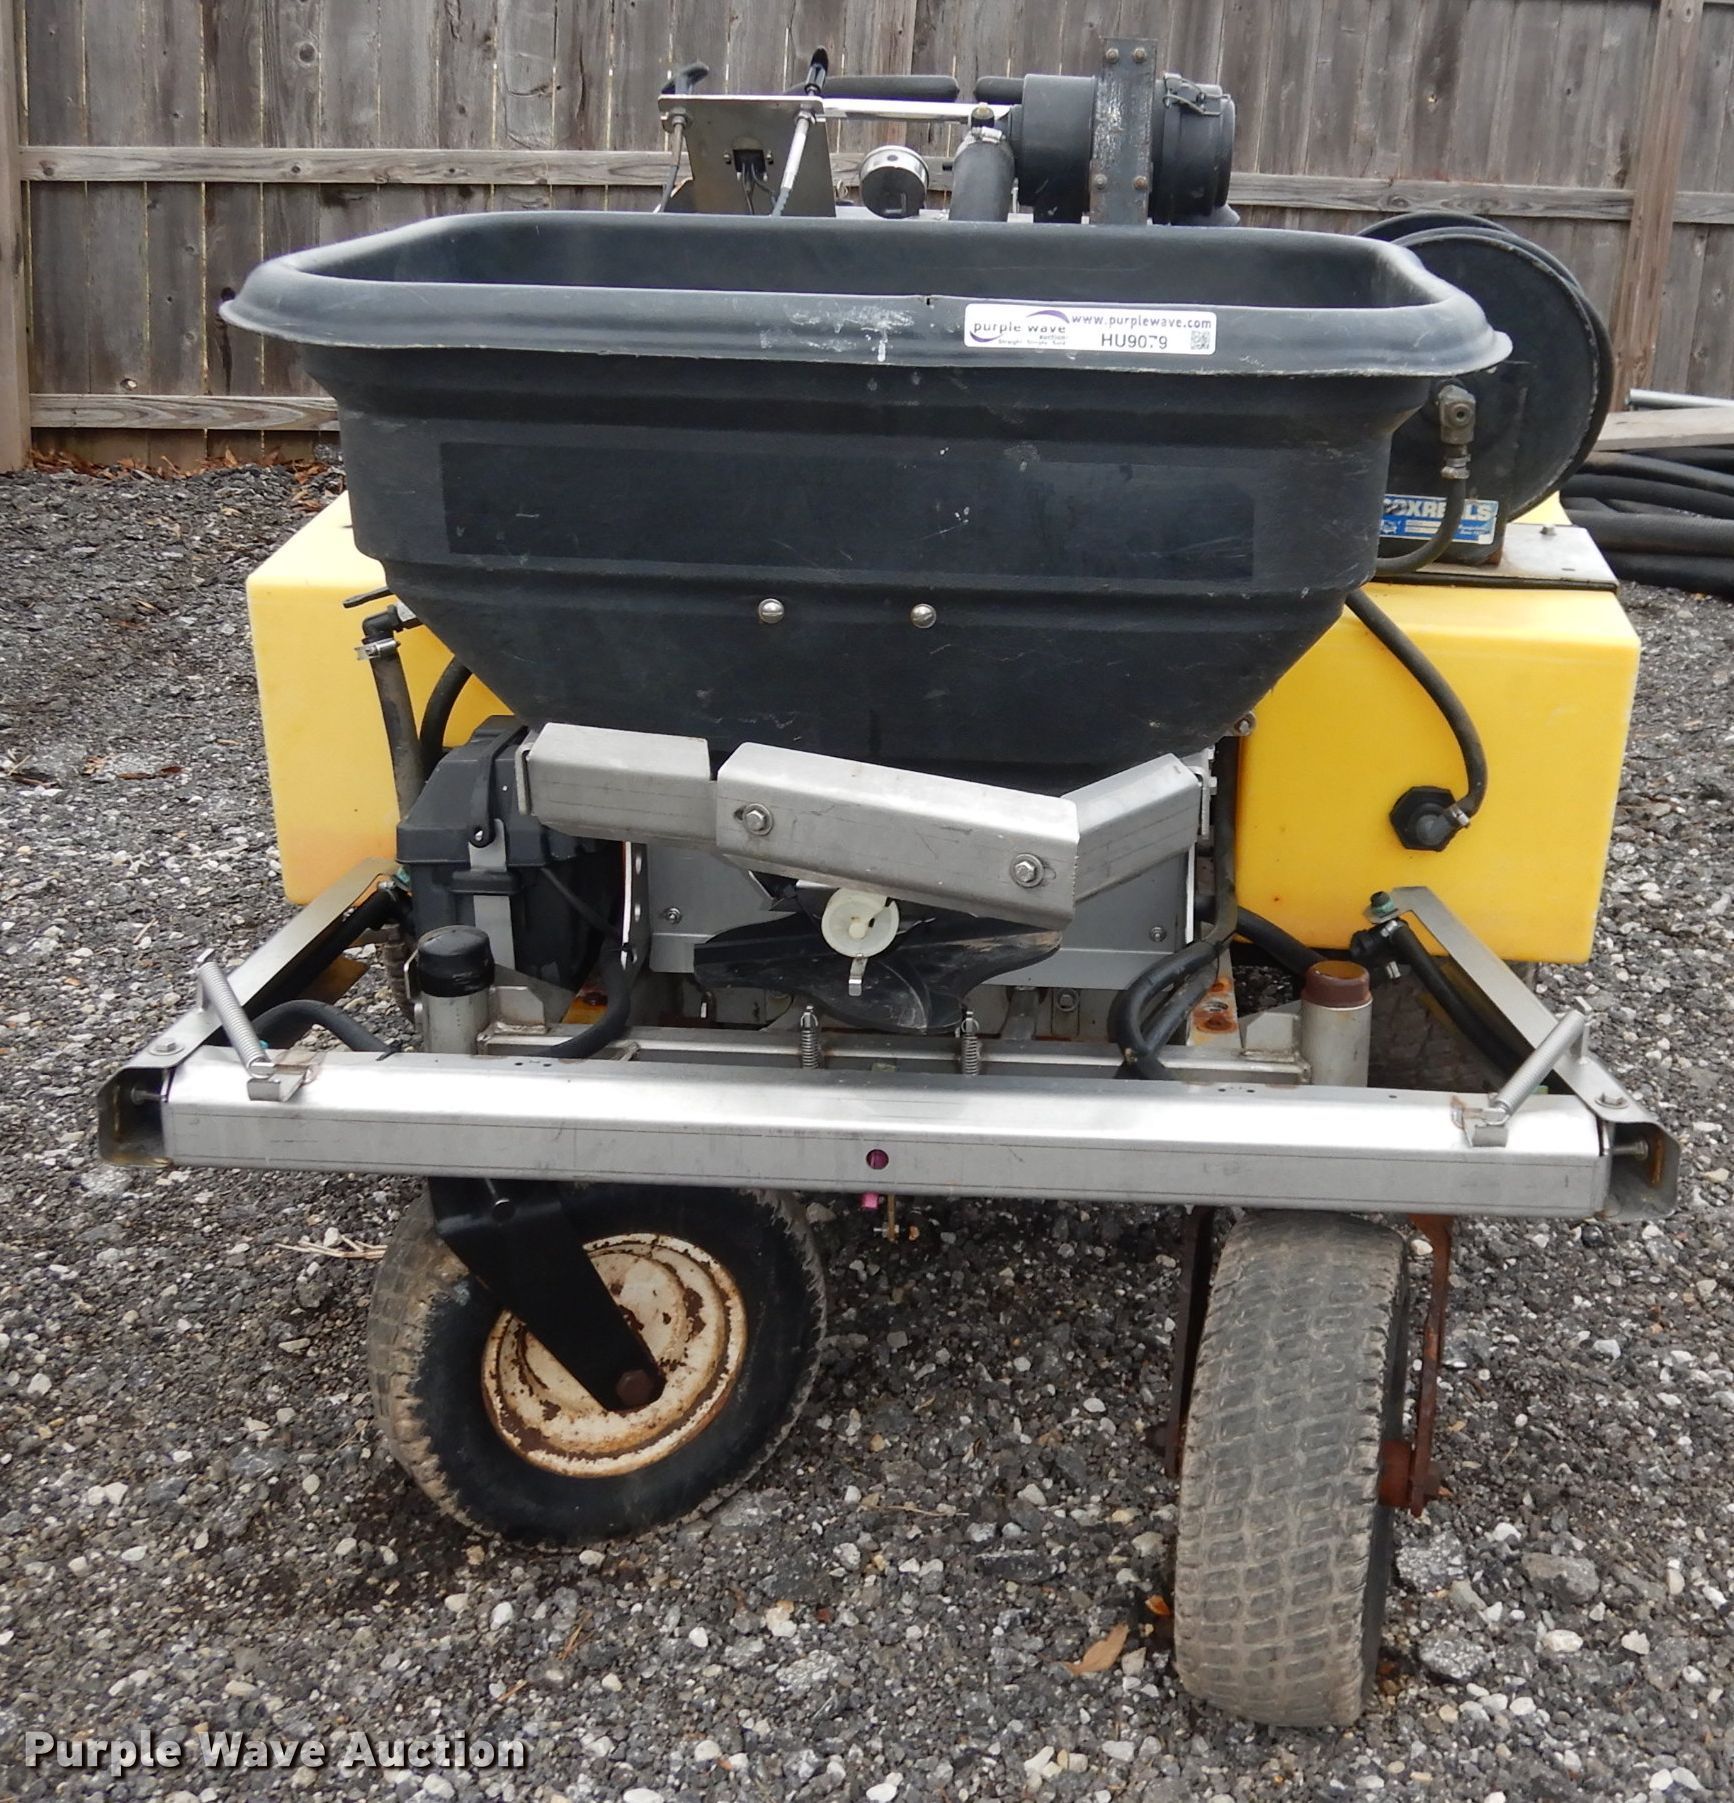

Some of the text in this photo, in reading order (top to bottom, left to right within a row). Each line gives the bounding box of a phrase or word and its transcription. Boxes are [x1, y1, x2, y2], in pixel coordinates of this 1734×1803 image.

[974, 321, 1021, 334] purple
[1072, 315, 1212, 328] www.purplewave.com
[1382, 498, 1492, 520] OXRELS
